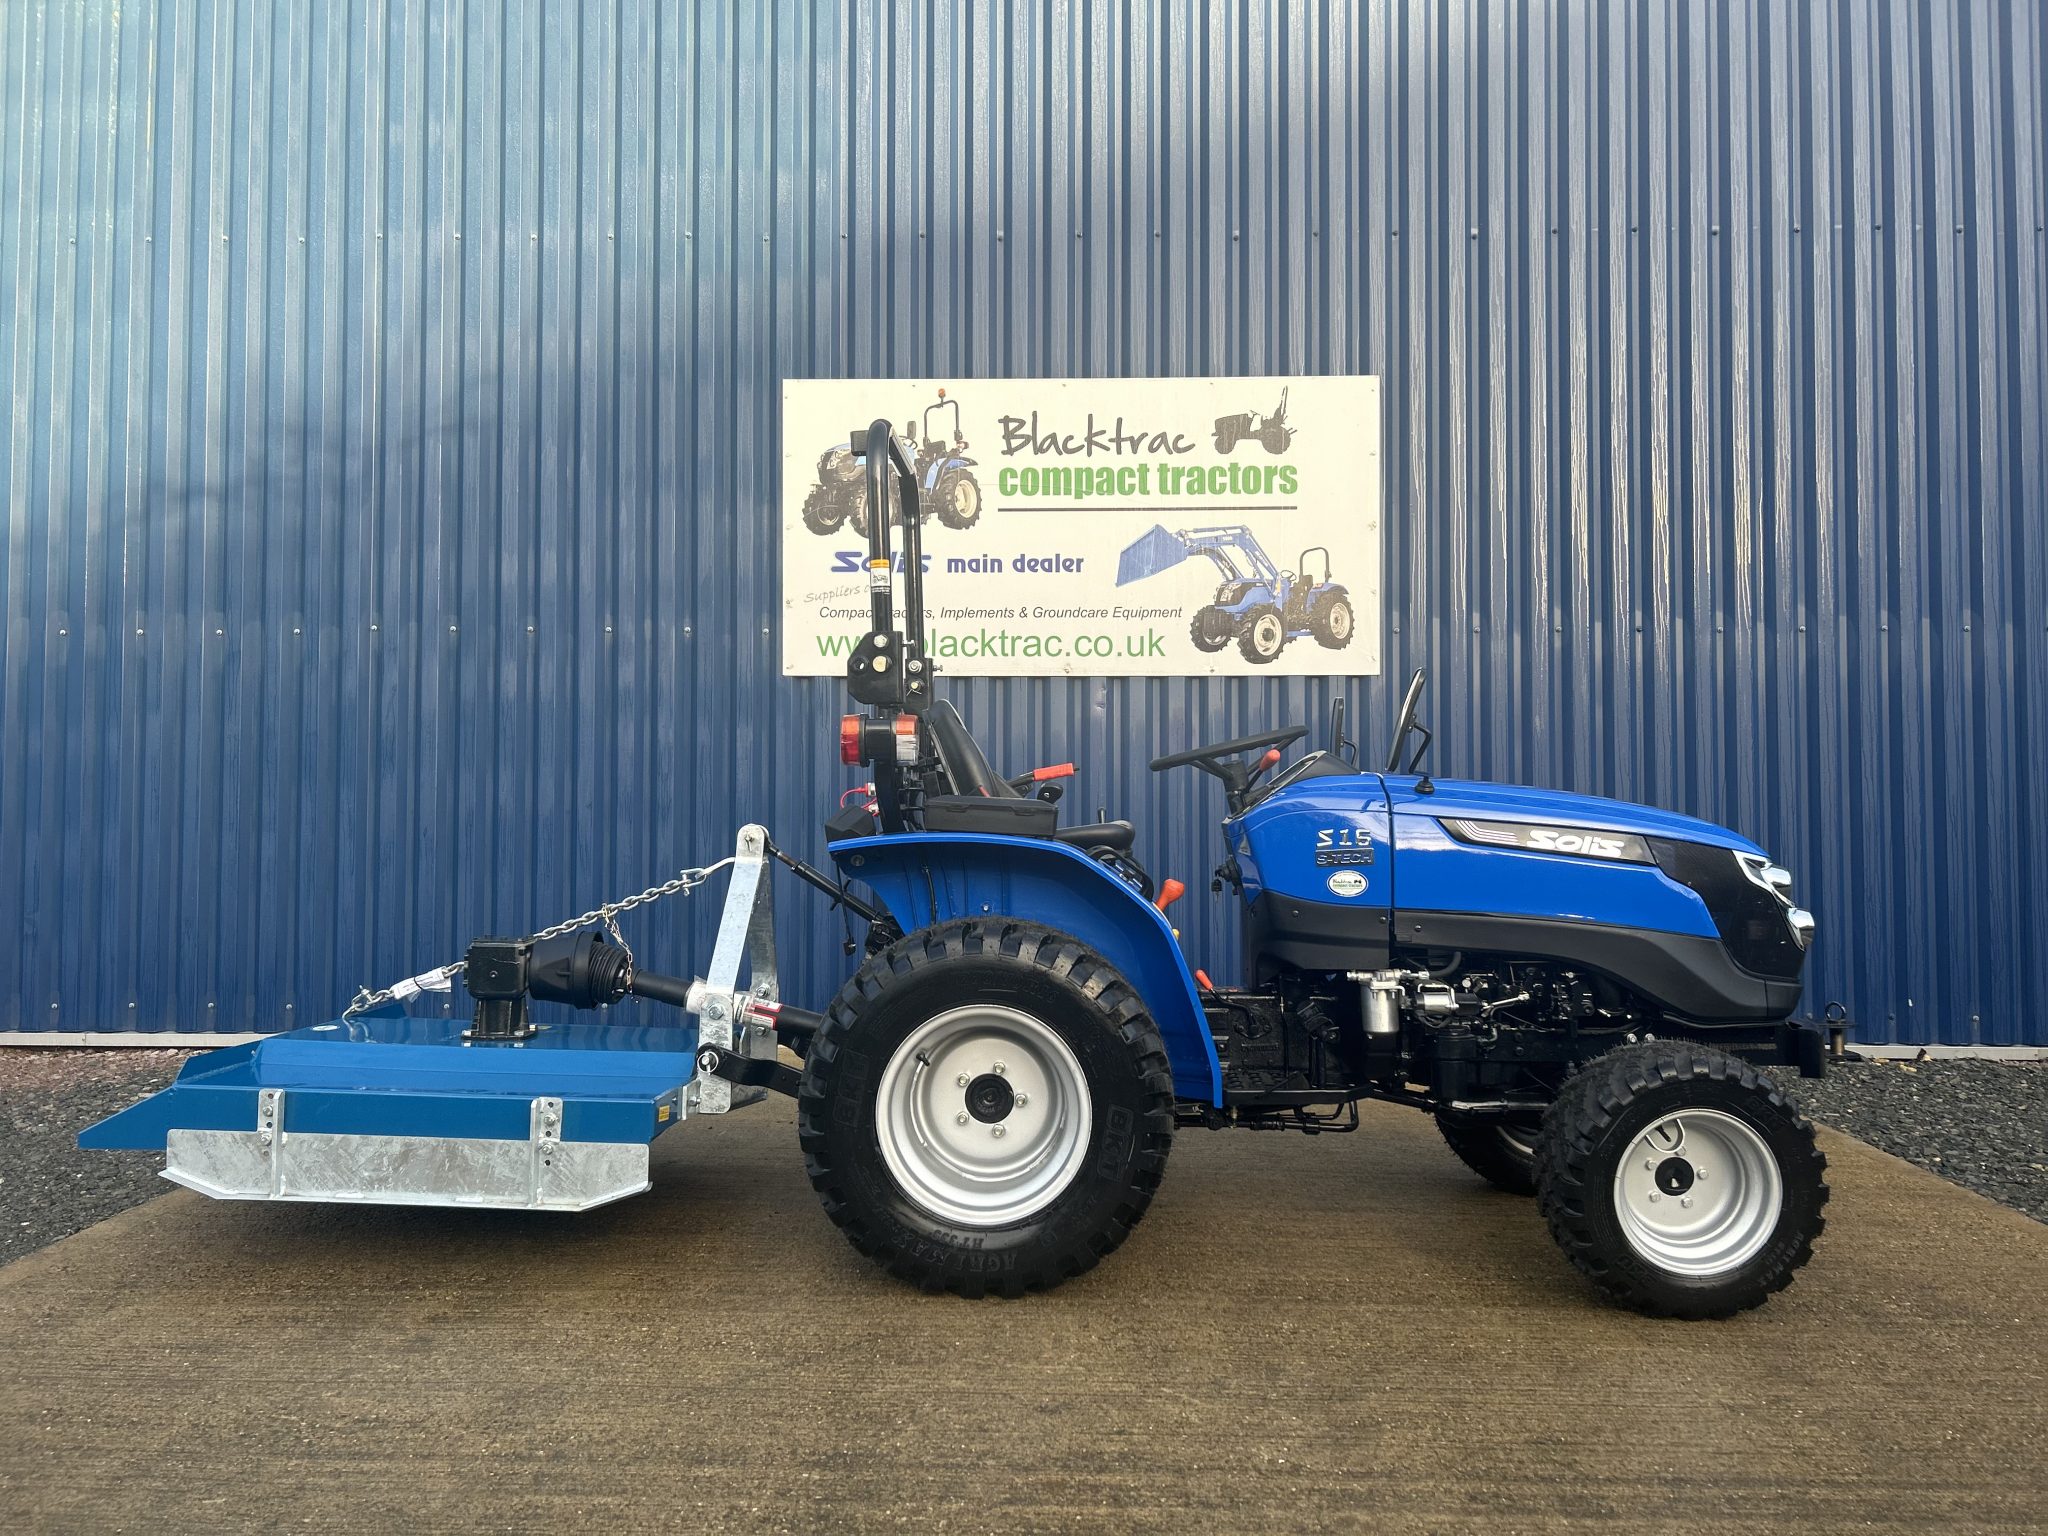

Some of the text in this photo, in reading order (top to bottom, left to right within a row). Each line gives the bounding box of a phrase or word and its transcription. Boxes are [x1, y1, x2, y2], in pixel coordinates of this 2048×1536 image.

[998, 411, 1195, 457] Blacktrac
[998, 462, 1298, 499] compact tractors
[947, 554, 1002, 573] main
[1012, 554, 1084, 573] dealer
[803, 585, 860, 604] Suppliers
[820, 606, 872, 620] Compac
[940, 606, 1014, 621] Implements
[1019, 606, 1028, 618] &
[1032, 606, 1108, 618] Groundcare
[1112, 606, 1182, 621] Equipment
[1527, 830, 1625, 857] Solis
[1316, 853, 1372, 865] S-TECH
